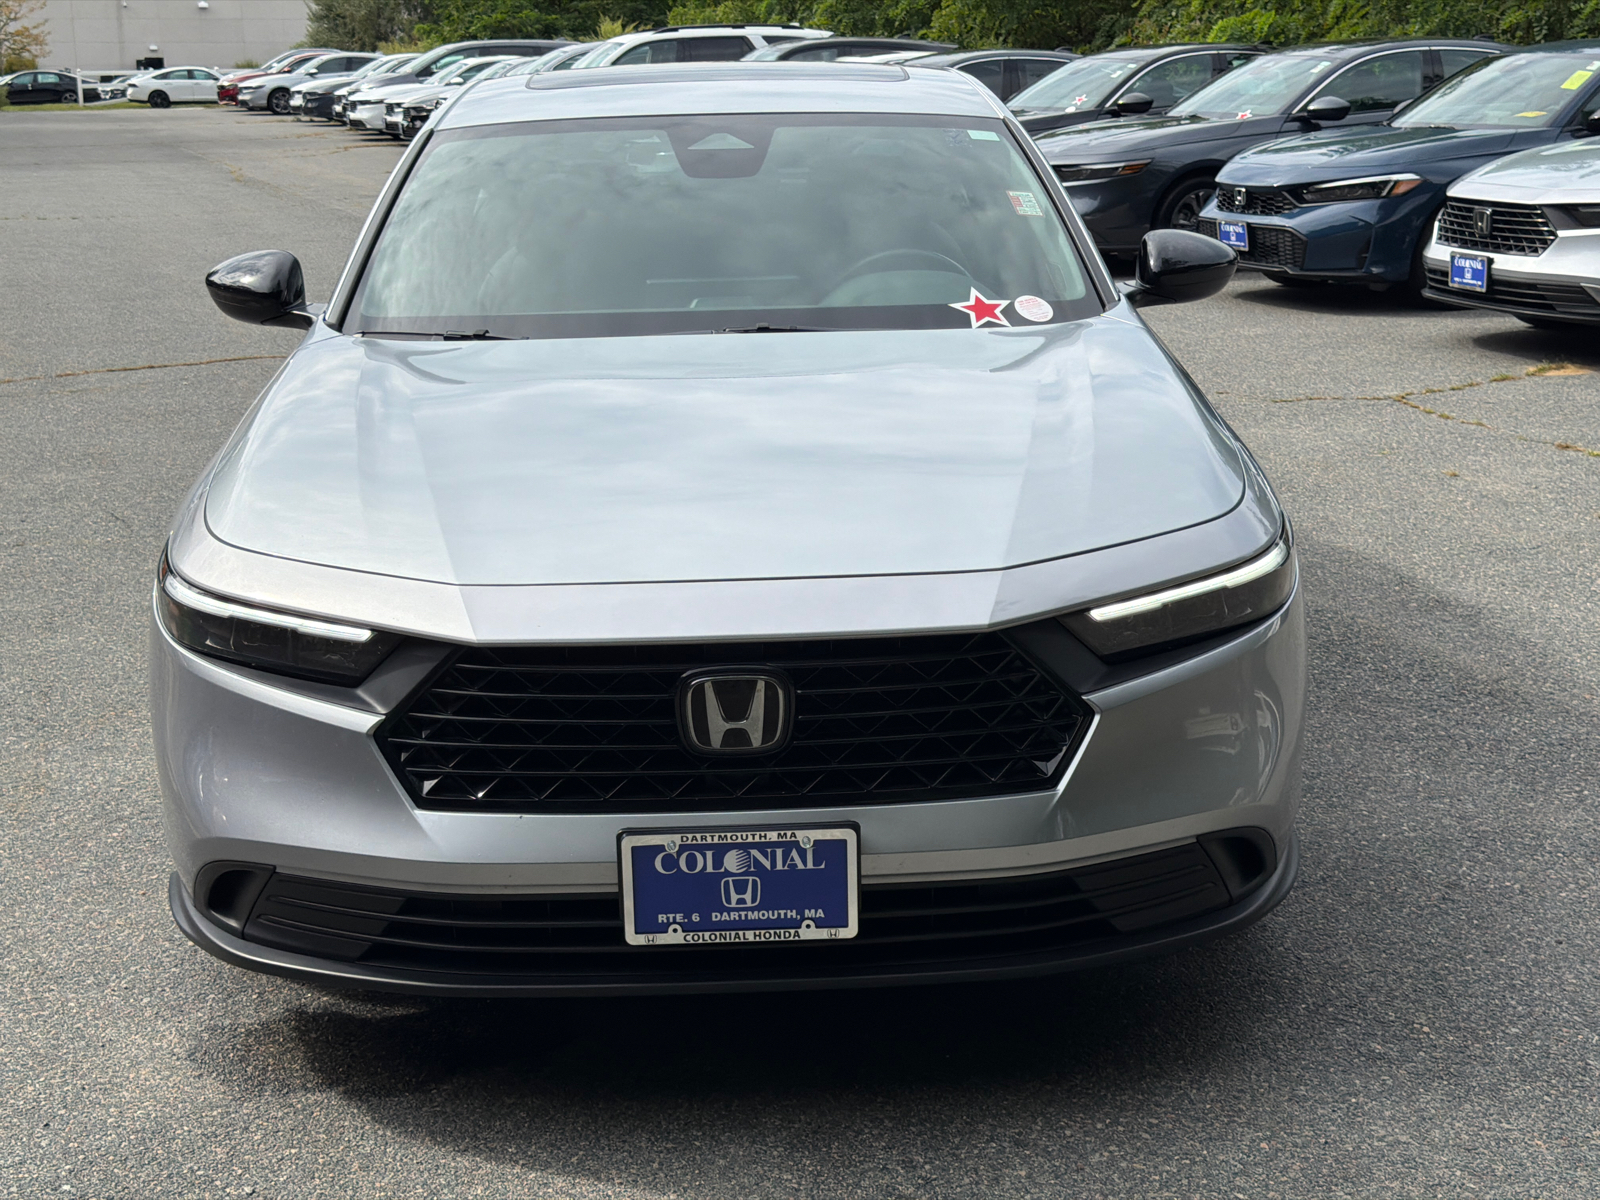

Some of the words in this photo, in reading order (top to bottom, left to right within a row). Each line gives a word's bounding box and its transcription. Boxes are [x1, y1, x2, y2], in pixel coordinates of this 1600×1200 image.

[680, 833, 772, 843] DARTMOUTH,
[777, 831, 797, 840] MA
[654, 847, 826, 875] COLONIAL
[657, 913, 688, 923] RTE.
[691, 912, 701, 922] 6
[711, 909, 801, 922] DARTMOUTH,
[804, 908, 825, 919] MA
[683, 932, 750, 943] COLONIAL
[753, 930, 801, 940] HONDA
